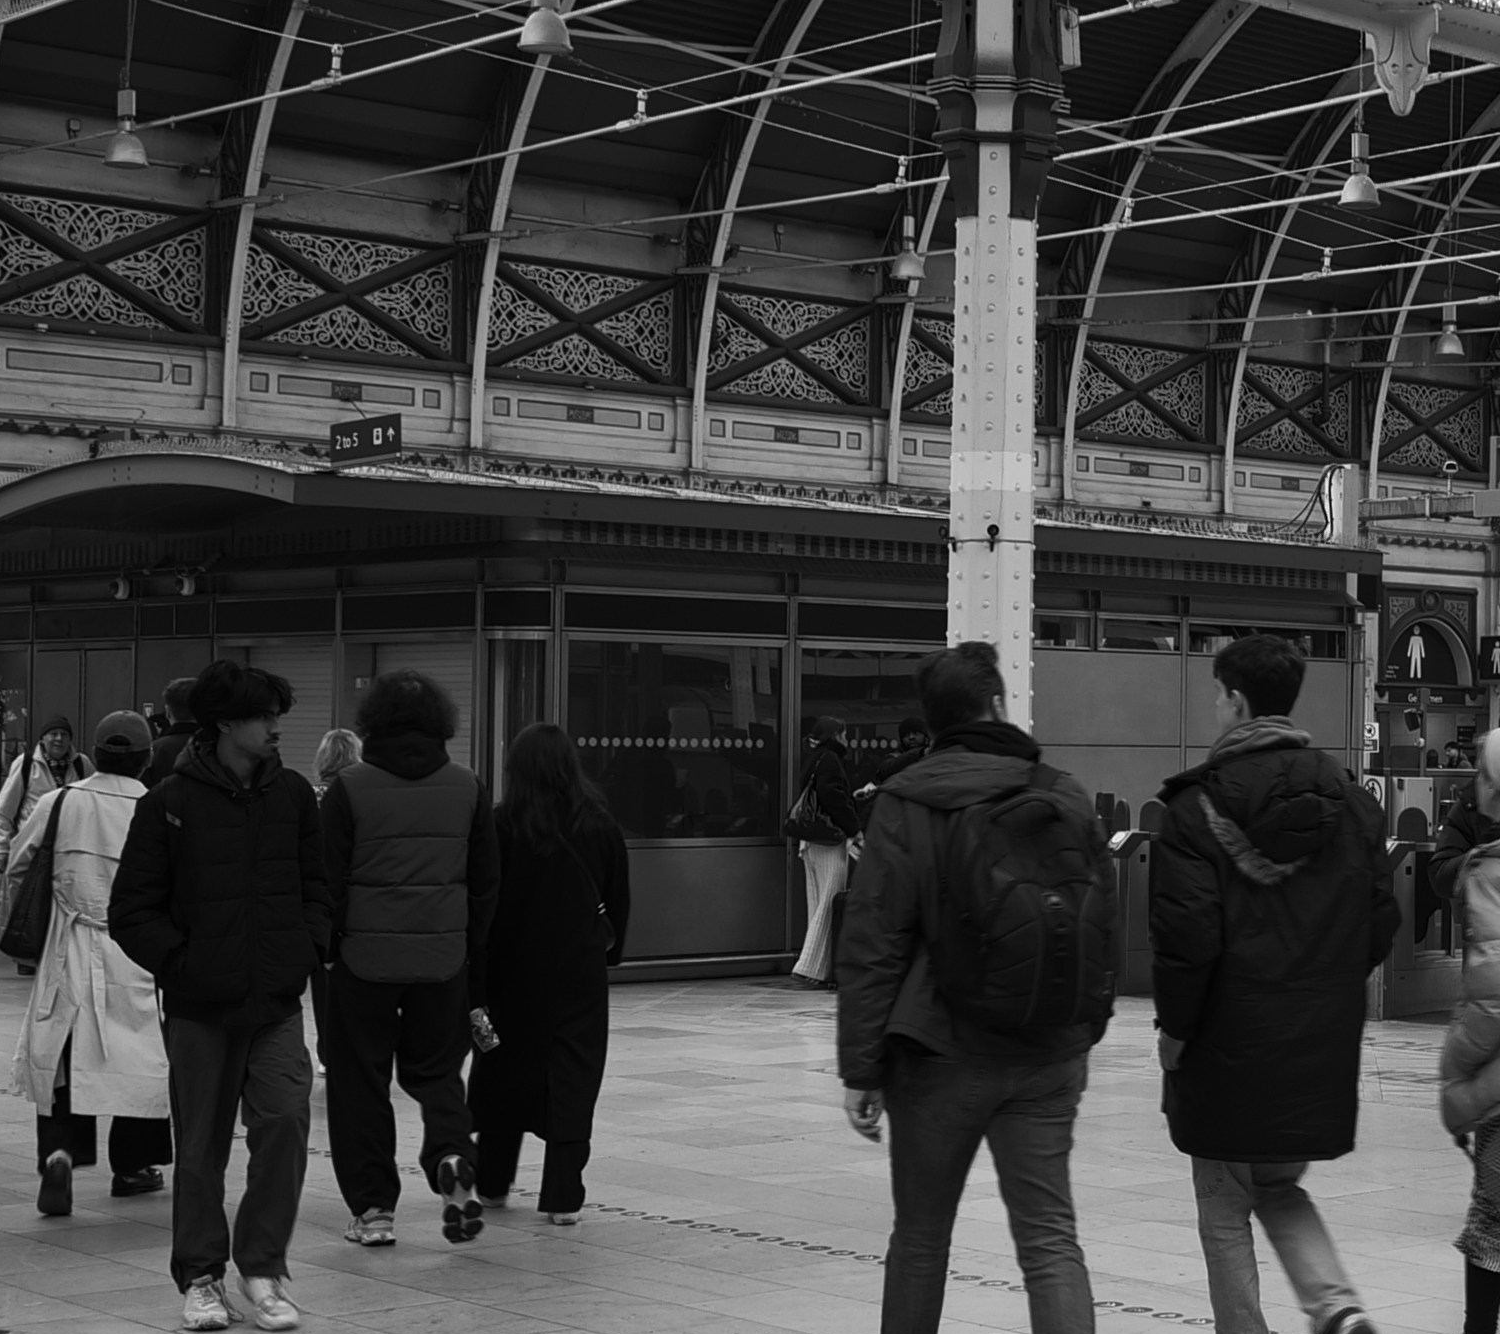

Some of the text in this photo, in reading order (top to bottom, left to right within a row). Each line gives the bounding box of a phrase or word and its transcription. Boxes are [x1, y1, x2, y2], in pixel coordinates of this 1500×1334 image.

[335, 432, 359, 450] 2 to 5
